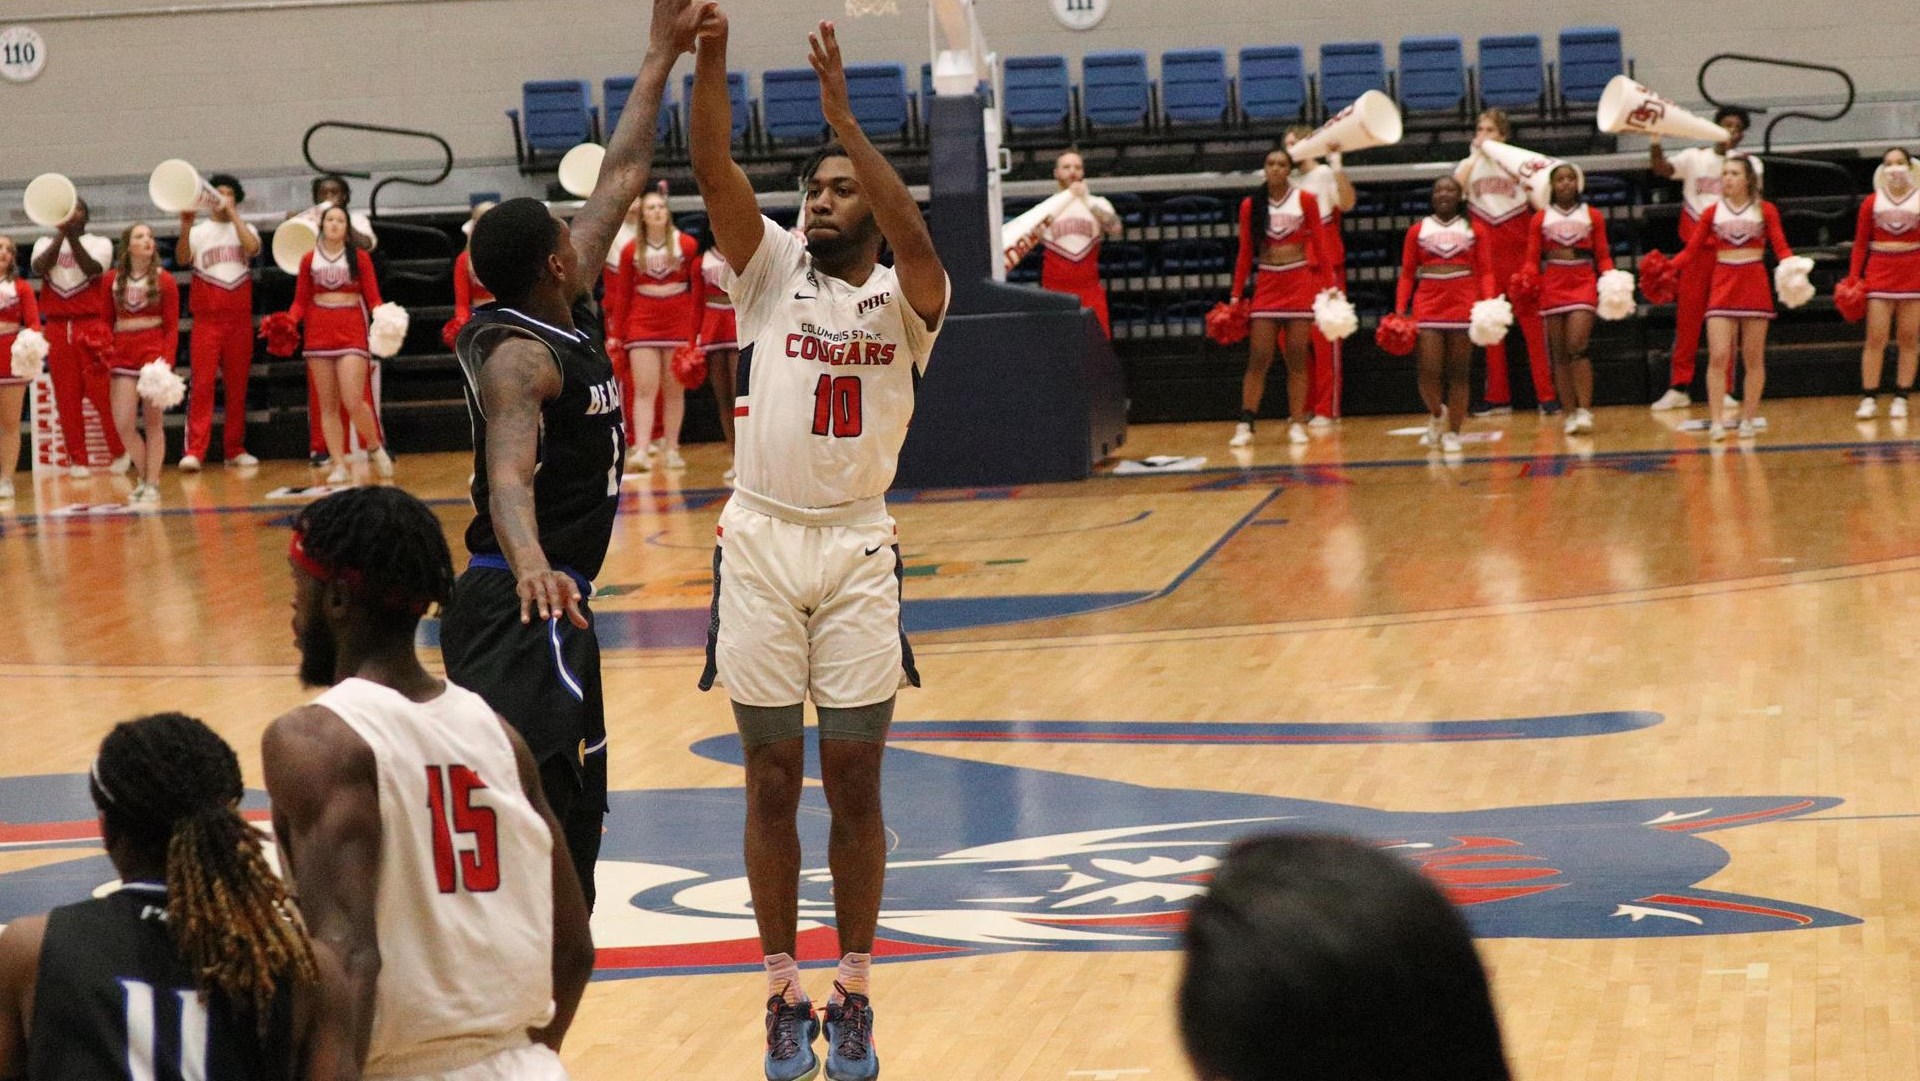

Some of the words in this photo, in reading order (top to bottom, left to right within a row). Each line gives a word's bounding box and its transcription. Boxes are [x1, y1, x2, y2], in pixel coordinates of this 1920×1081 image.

[4, 43, 35, 64] 110
[857, 292, 890, 314] PBC
[785, 333, 897, 366] COUGARS
[811, 373, 863, 438] 10
[425, 764, 501, 893] 15
[115, 976, 209, 1081] 11
